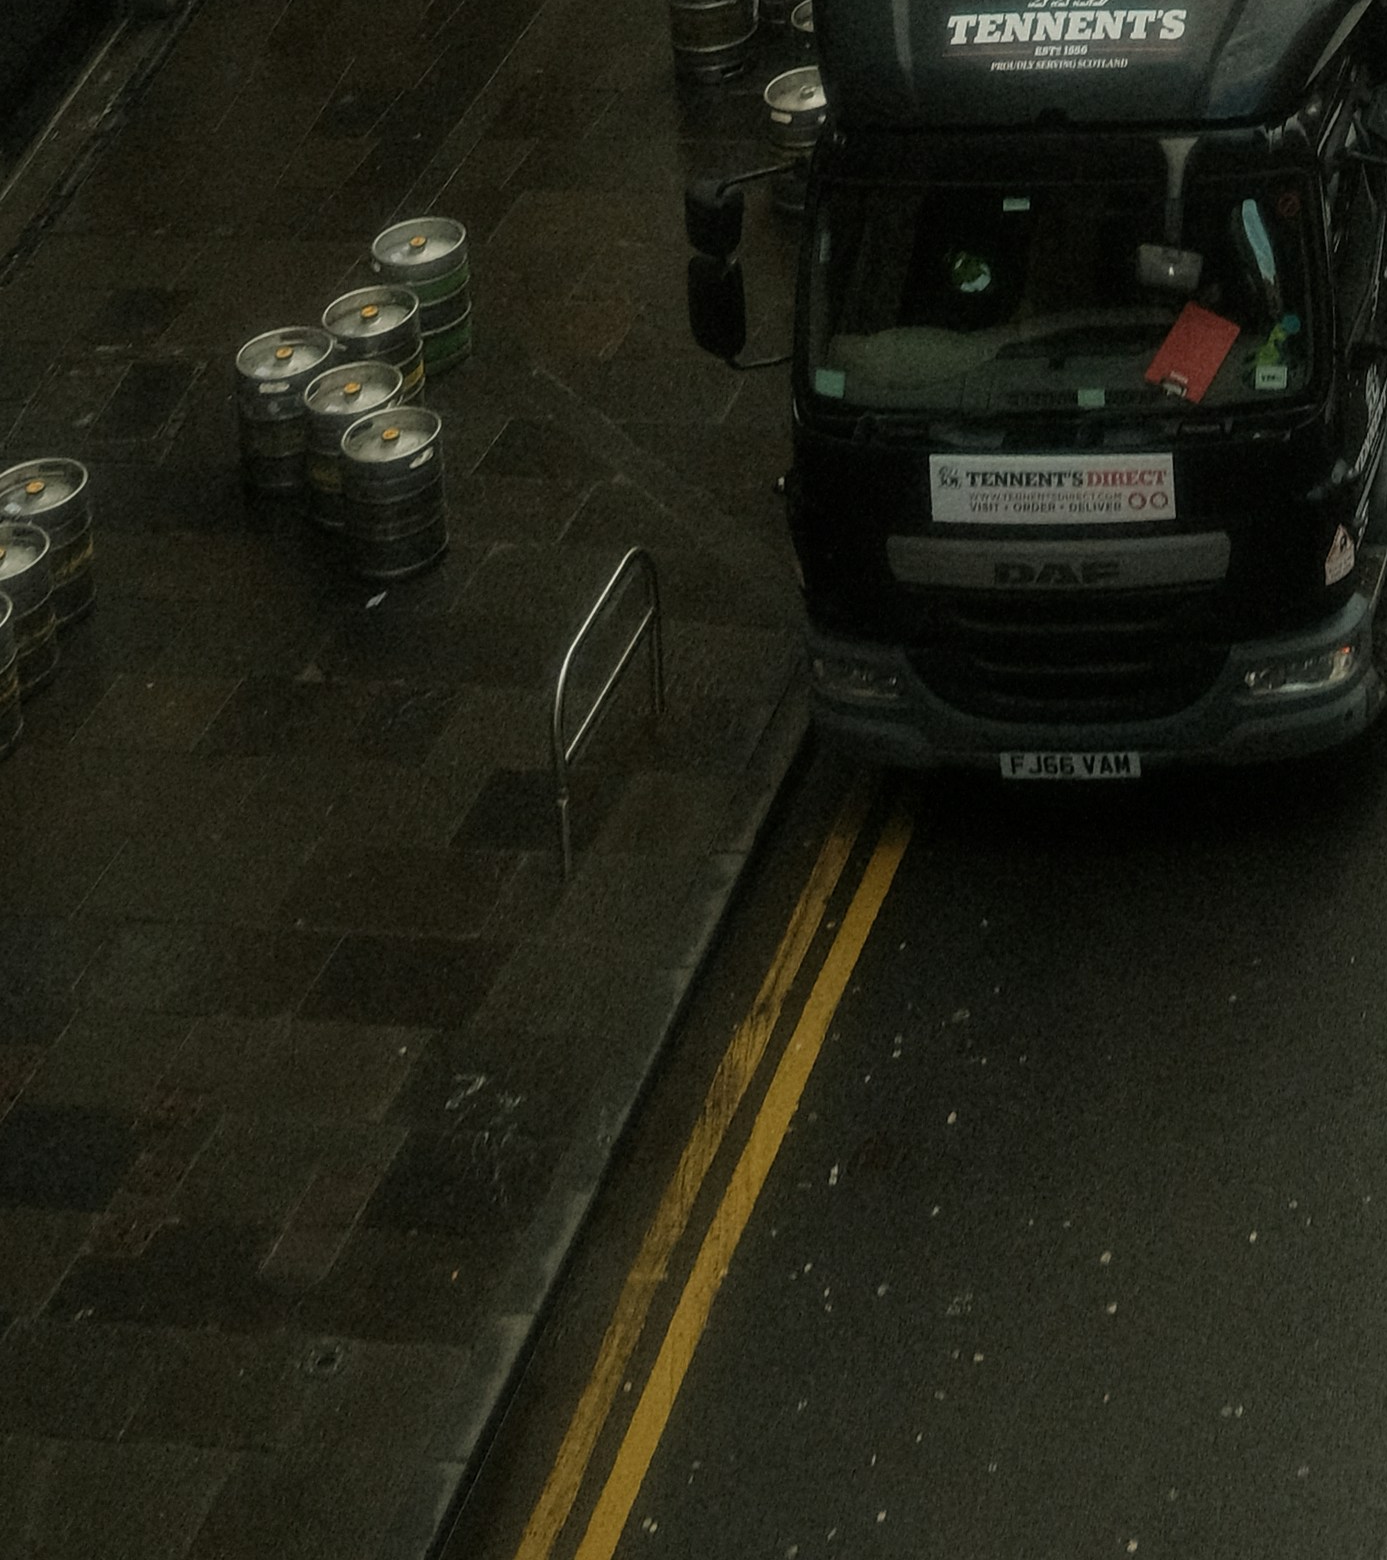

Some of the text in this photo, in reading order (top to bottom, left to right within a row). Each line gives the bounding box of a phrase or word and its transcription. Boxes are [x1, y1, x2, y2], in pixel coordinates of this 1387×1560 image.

[948, 9, 1187, 45] TENNENT'S
[990, 58, 1128, 72] PROUDLY SERVING SCOTLAND
[966, 470, 1167, 488] TENNENT'S DIRECT
[970, 502, 1122, 512] VISIT ORDER DELIVER
[994, 562, 1120, 584] DAF
[1010, 755, 1131, 774] FJ66 VAM
